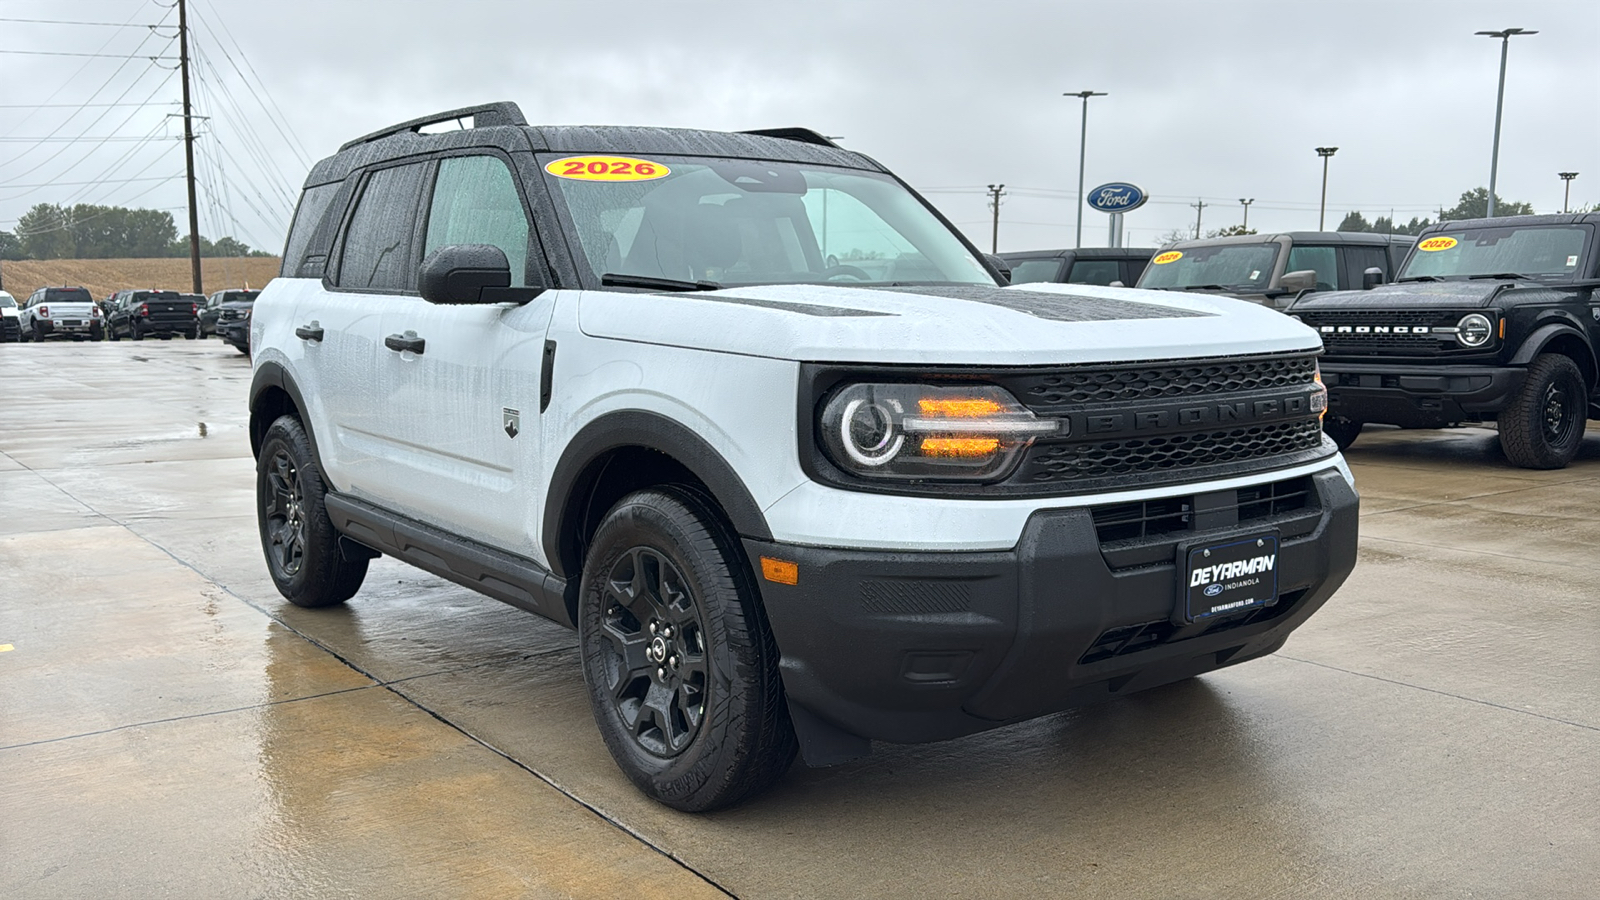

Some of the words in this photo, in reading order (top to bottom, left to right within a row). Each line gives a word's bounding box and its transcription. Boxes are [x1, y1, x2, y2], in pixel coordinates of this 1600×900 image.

[562, 161, 655, 176] 2026
[1097, 188, 1131, 206] Ford
[1421, 240, 1454, 249] 2026
[1156, 252, 1180, 262] 2026
[1087, 397, 1304, 433] BRONCO
[1190, 554, 1275, 587] DEYARMAN
[1224, 577, 1260, 591] INDIANOLA
[1211, 598, 1254, 613] DEYARMANFORD.COM
